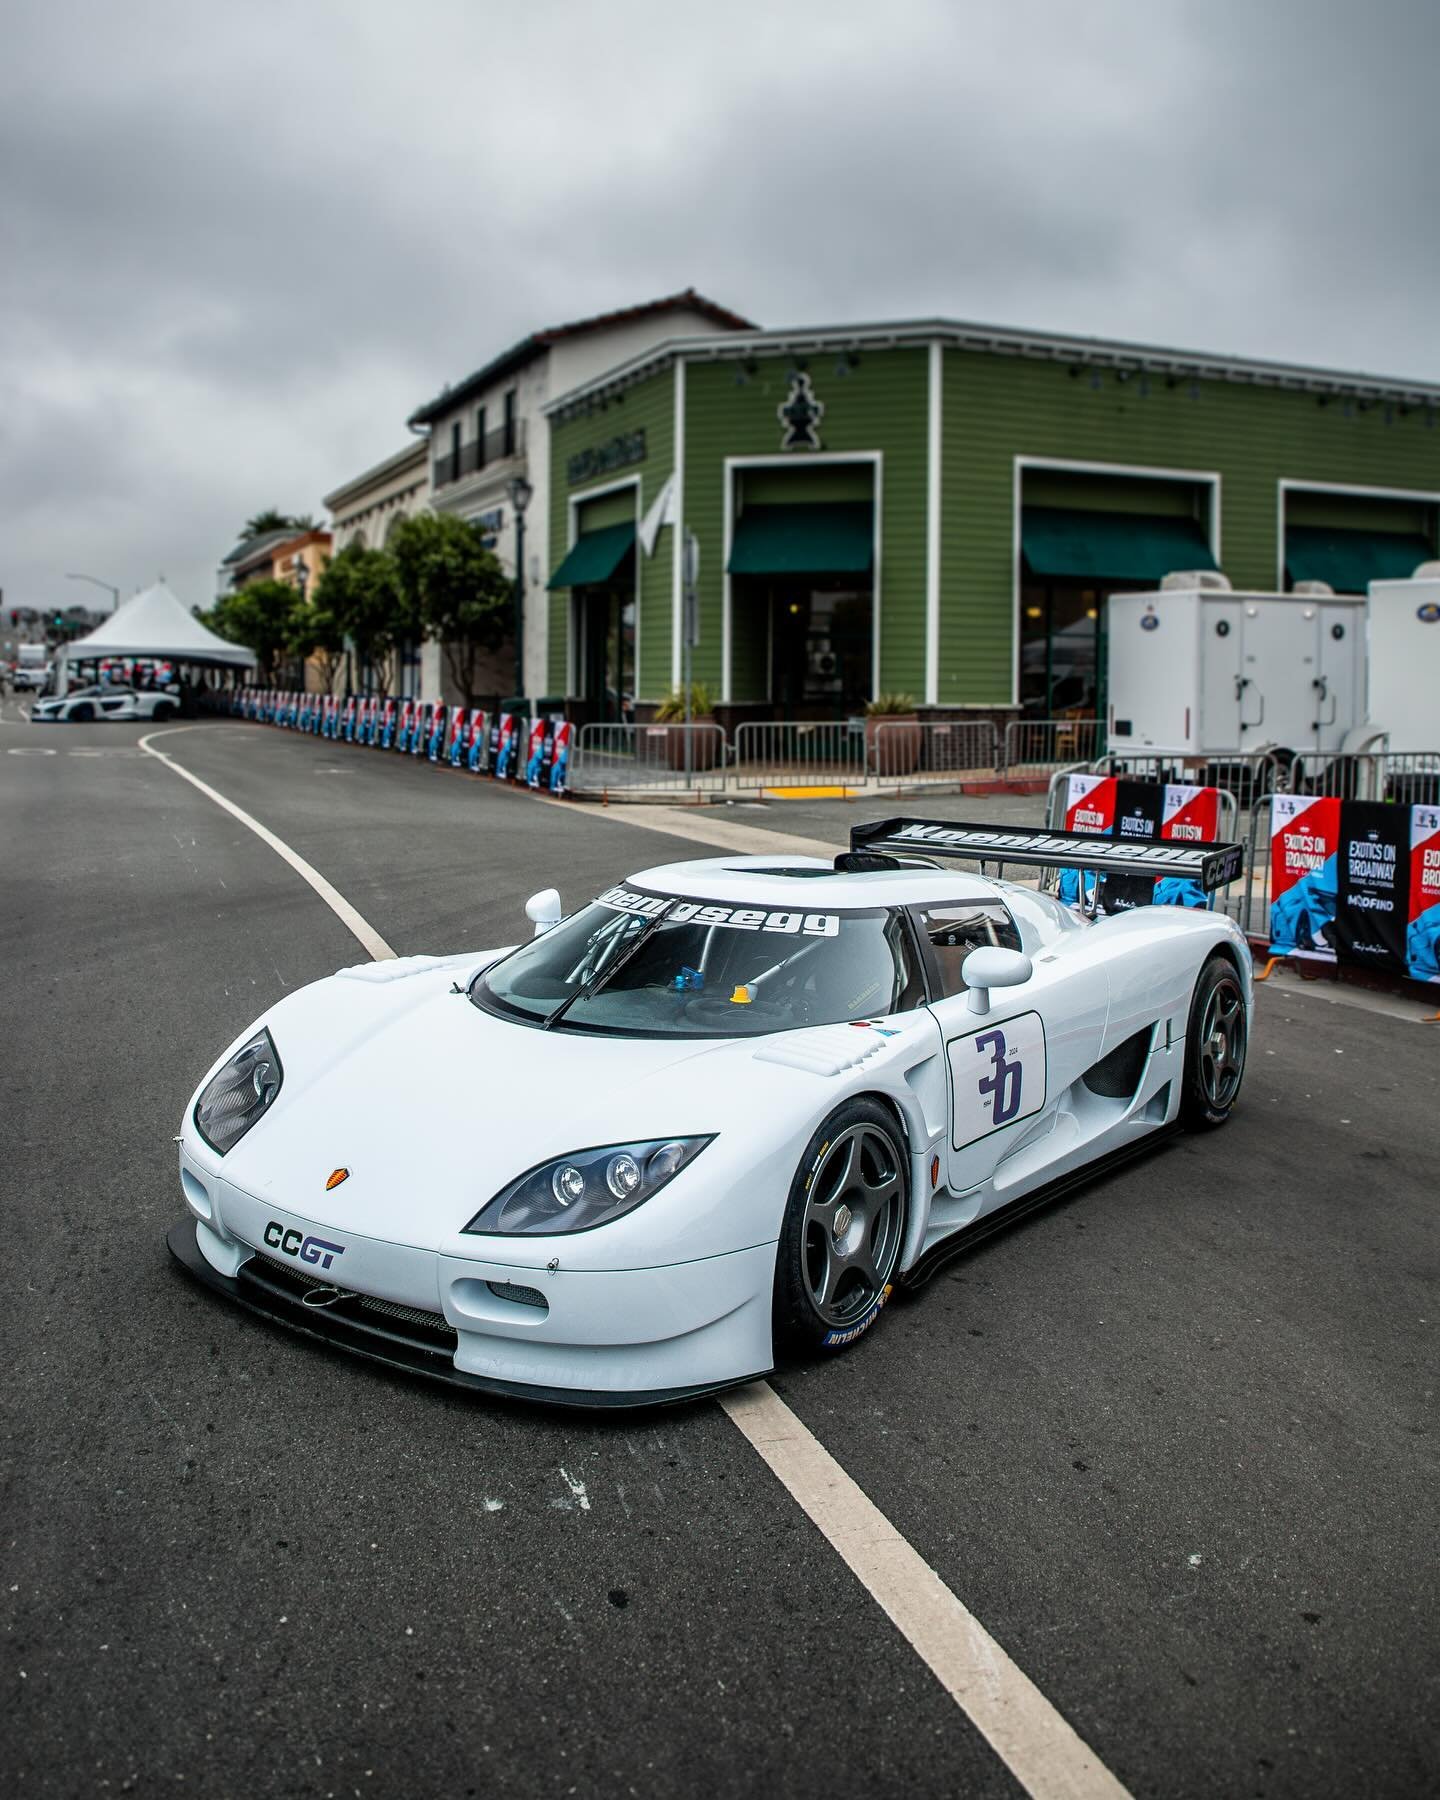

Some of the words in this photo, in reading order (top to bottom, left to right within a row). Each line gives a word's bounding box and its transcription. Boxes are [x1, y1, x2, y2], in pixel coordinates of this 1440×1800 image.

[1144, 819, 1155, 834] ON
[1314, 836, 1326, 854] ON
[1349, 840, 1383, 860] EXOTICS
[1383, 844, 1396, 862] ON
[1349, 859, 1396, 881] BROADWAY
[597, 886, 840, 937] oenigsegg
[263, 1220, 347, 1270] CCGT
[827, 1307, 878, 1345] MICHELIN
